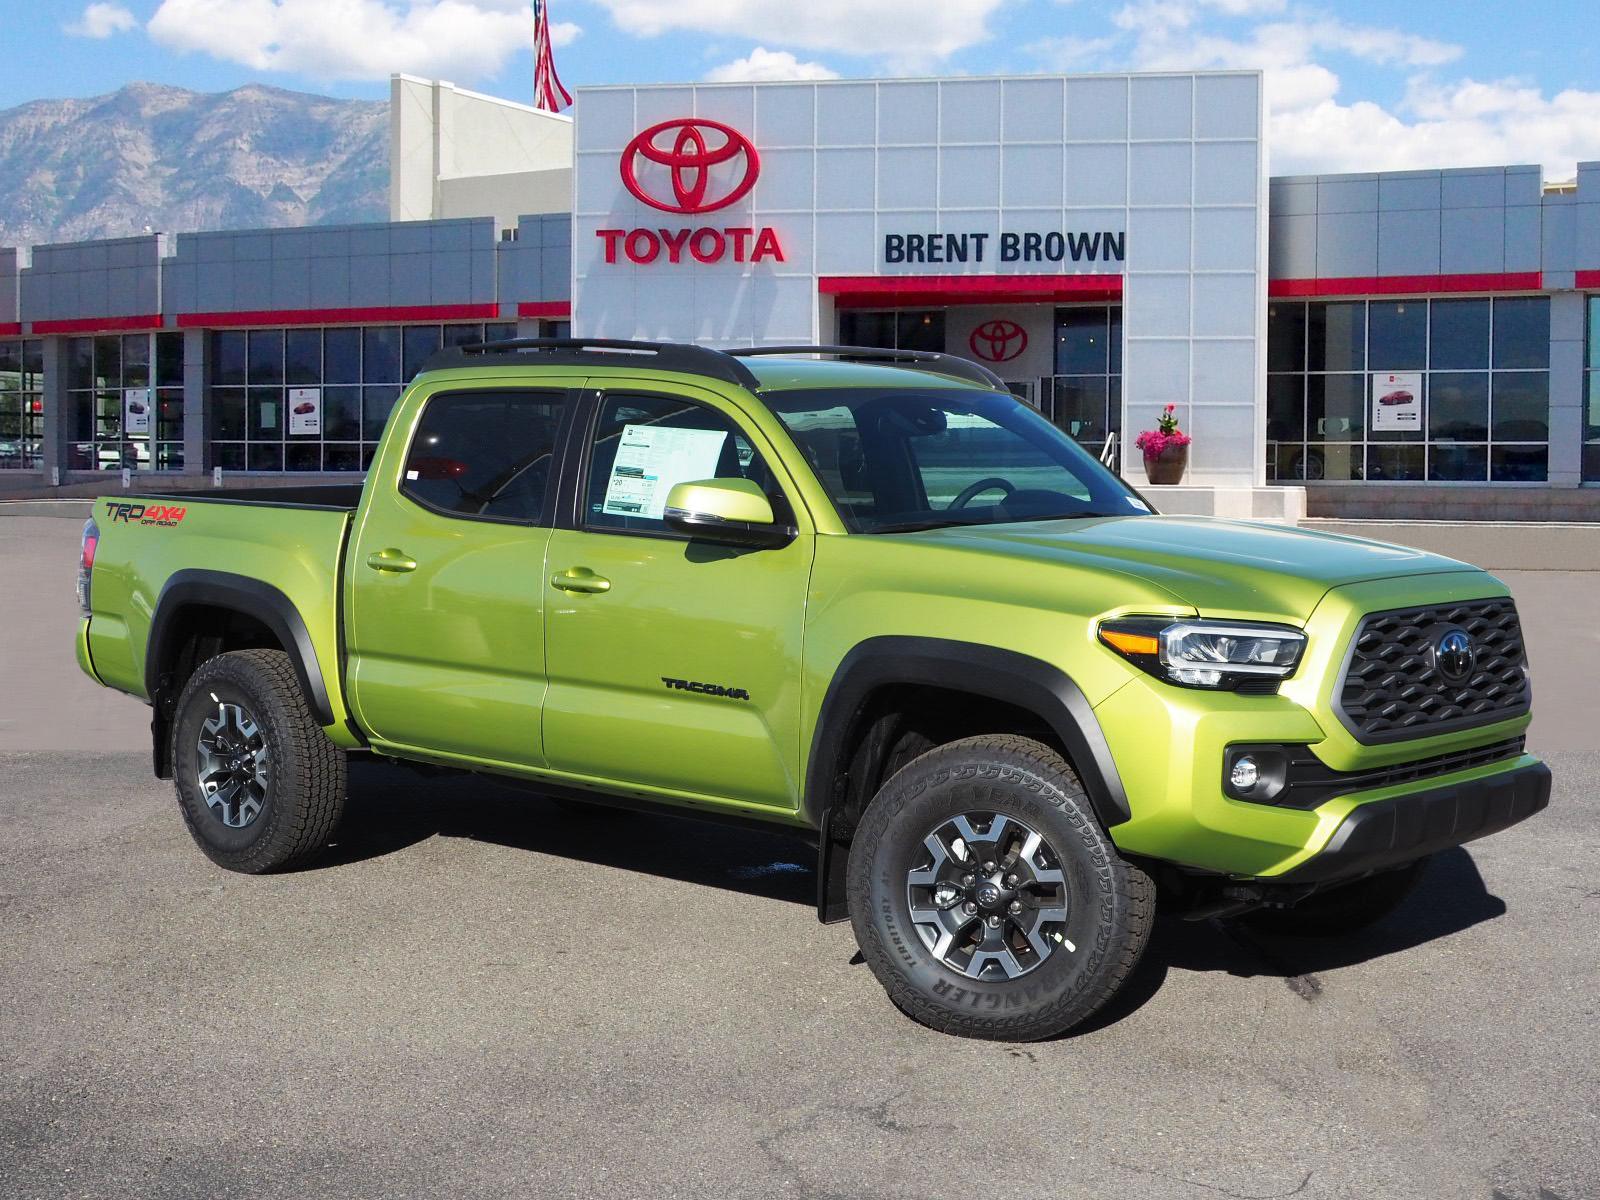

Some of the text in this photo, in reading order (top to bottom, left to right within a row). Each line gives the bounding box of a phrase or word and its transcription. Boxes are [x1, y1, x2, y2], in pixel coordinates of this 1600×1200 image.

[596, 227, 784, 264] TOYOTA
[885, 231, 1126, 263] BRENT BROWN
[106, 502, 145, 523] TRD
[661, 677, 750, 701] TACOMA
[881, 896, 917, 969] TERRITORY
